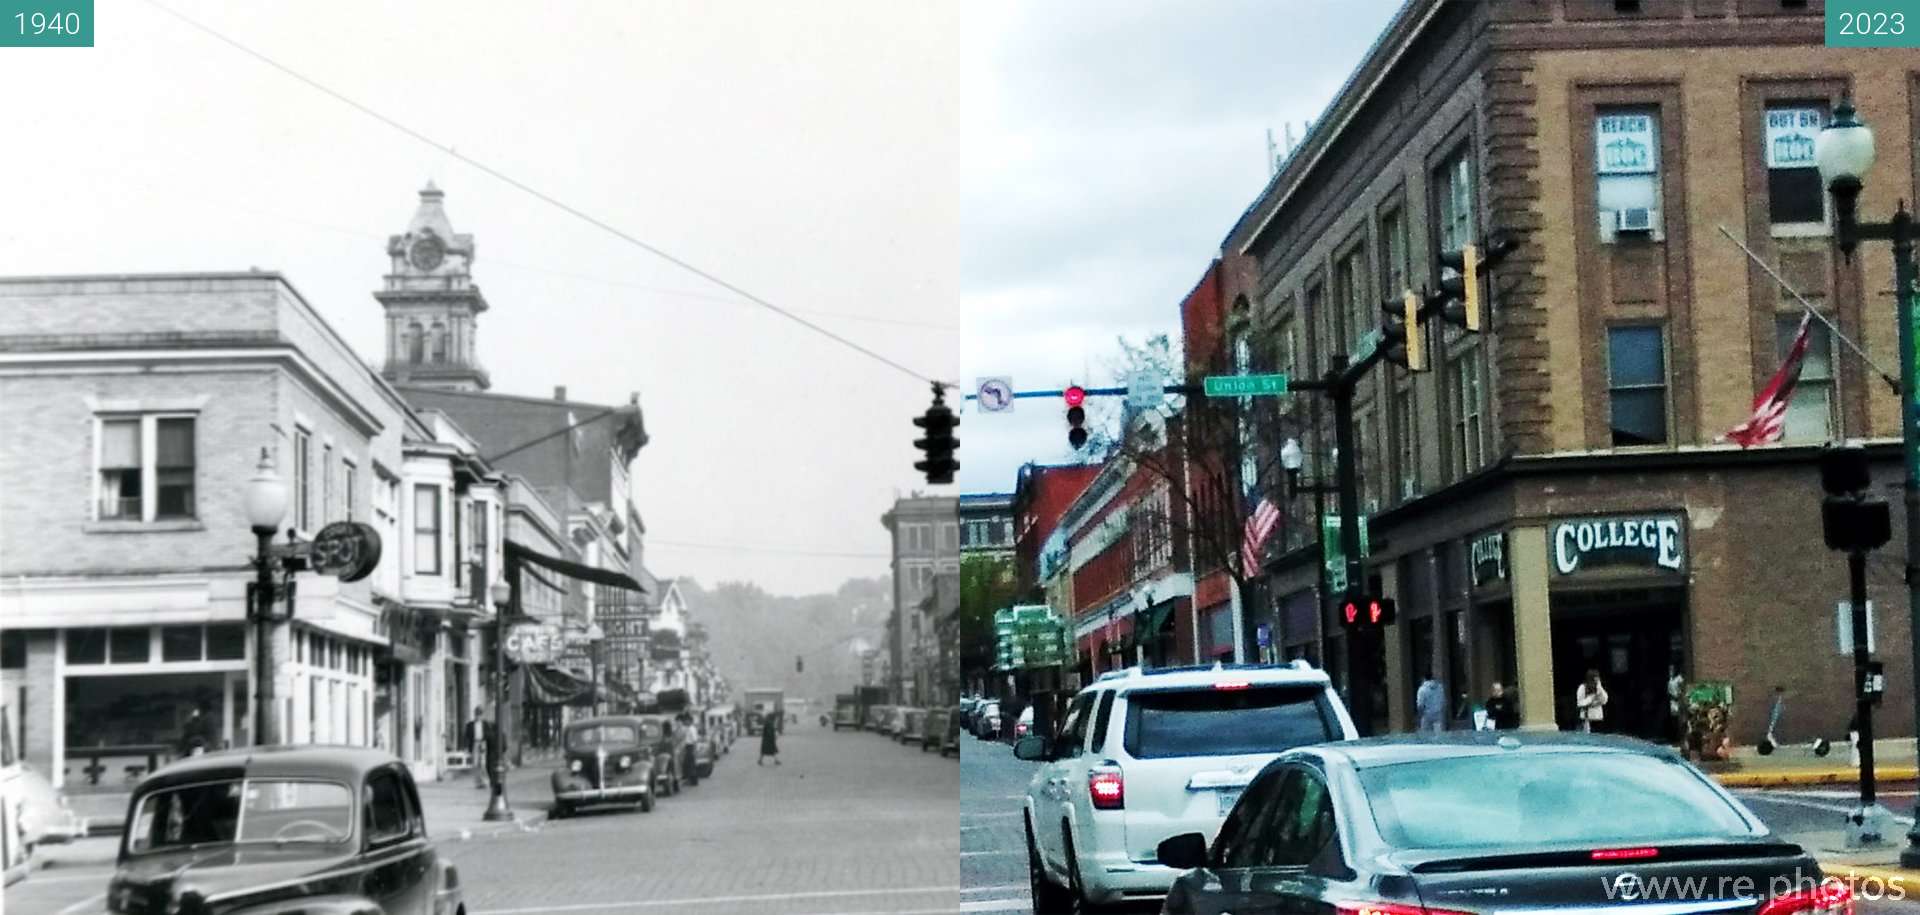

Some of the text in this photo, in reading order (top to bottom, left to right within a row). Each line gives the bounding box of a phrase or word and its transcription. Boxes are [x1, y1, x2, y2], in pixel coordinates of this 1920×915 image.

[1213, 379, 1277, 391] Union St
[314, 536, 363, 566] SPOT
[1555, 519, 1681, 574] COLLEGE
